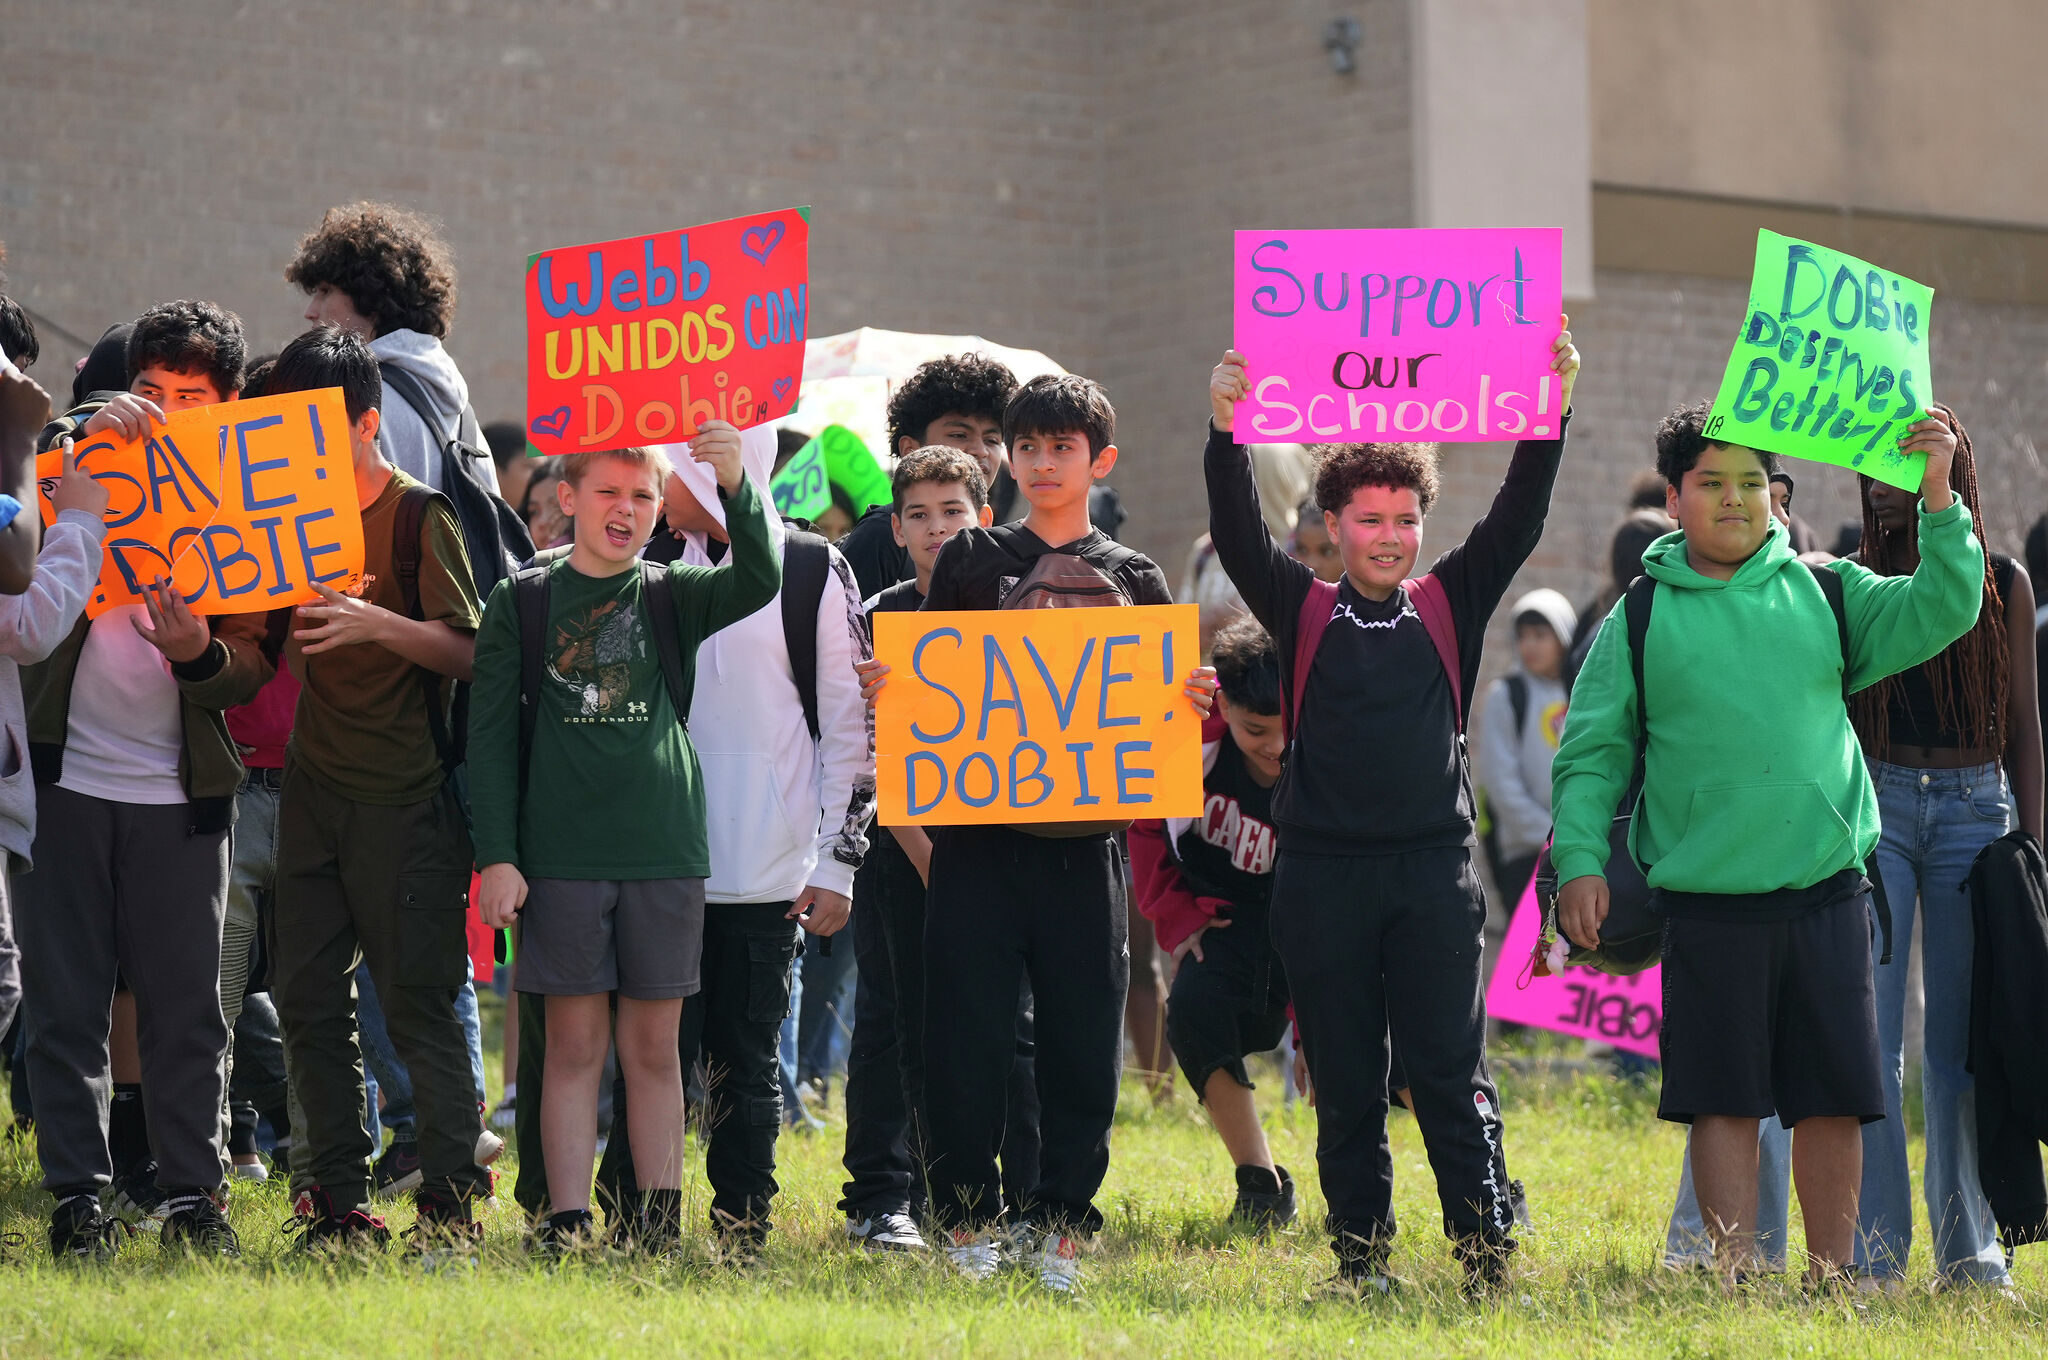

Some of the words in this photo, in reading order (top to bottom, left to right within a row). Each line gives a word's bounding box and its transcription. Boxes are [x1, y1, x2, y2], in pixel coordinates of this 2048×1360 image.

[538, 233, 711, 319] Webb
[1251, 239, 1541, 338] Support
[545, 303, 736, 380] UNIDOS
[744, 283, 807, 350] CON
[579, 370, 753, 446] Dobie
[755, 400, 768, 423] 19
[1251, 373, 1551, 437] Schools!
[1704, 415, 1725, 437] 18
[74, 403, 327, 529] SAVE!
[107, 507, 349, 604] DOBIE
[909, 626, 1174, 744] SAVE!
[904, 740, 1156, 817] DOBIE
[1557, 983, 1662, 1041] OBIE
